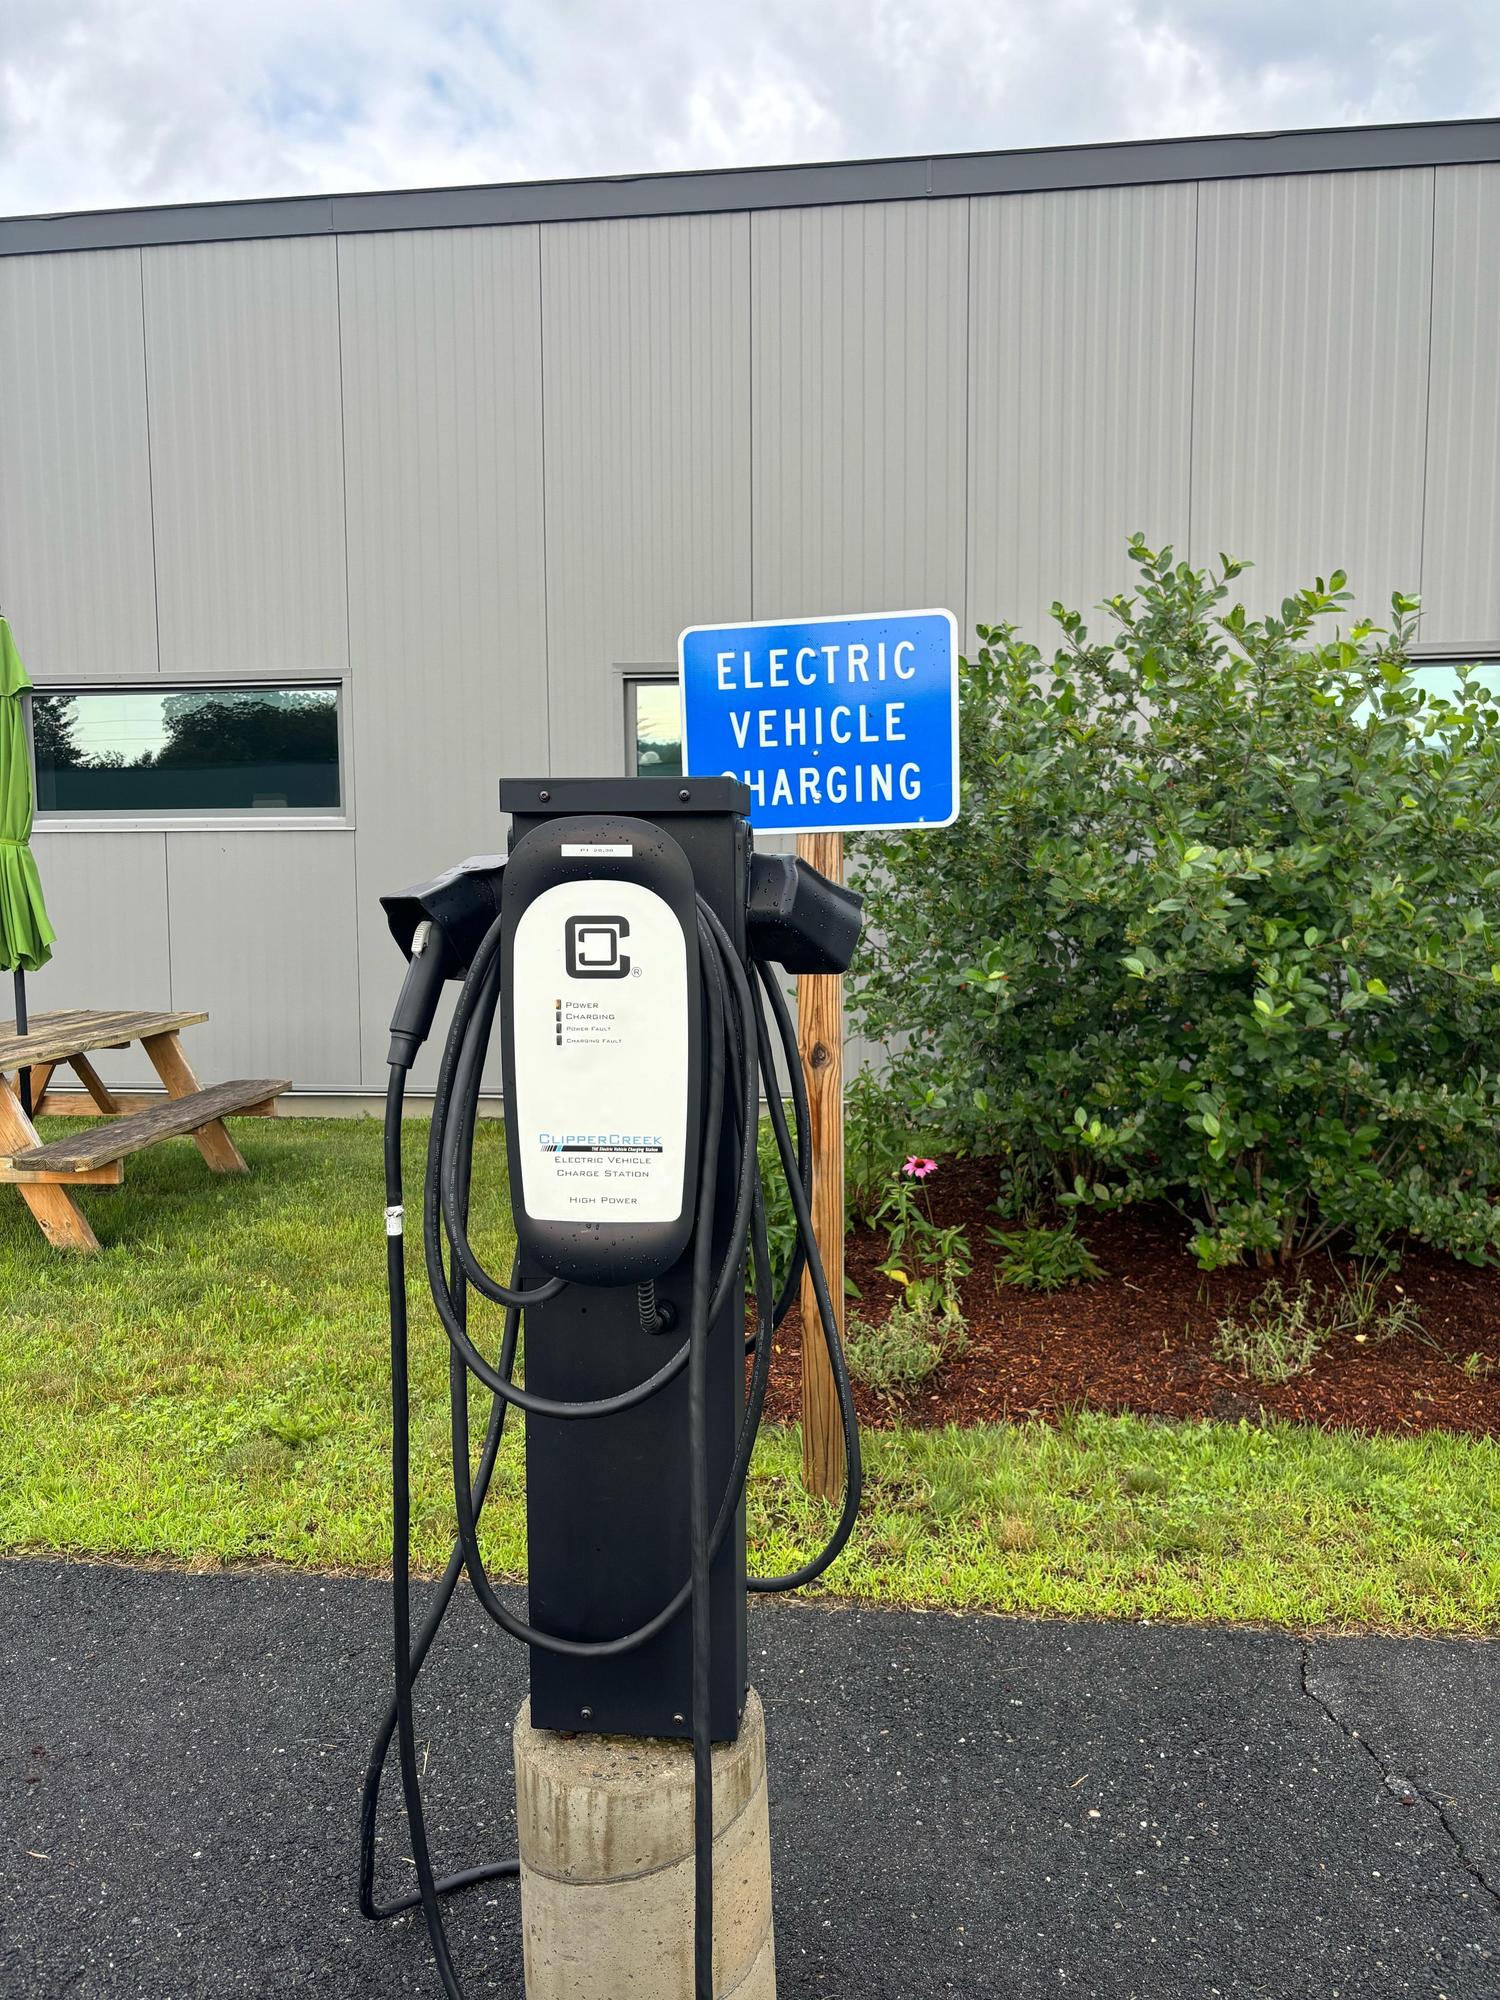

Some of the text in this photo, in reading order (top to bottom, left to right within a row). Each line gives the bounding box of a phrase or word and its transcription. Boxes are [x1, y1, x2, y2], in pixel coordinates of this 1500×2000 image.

[716, 640, 916, 691] ELECTRIC
[729, 702, 906, 749] VEHICLE
[720, 762, 921, 807] HARGING
[565, 1001, 599, 1009] POWER
[554, 1156, 652, 1164] ELECTRIC VEHICLE
[556, 1169, 649, 1178] CHARGE STATION
[569, 1196, 638, 1205] HIGH POWER
